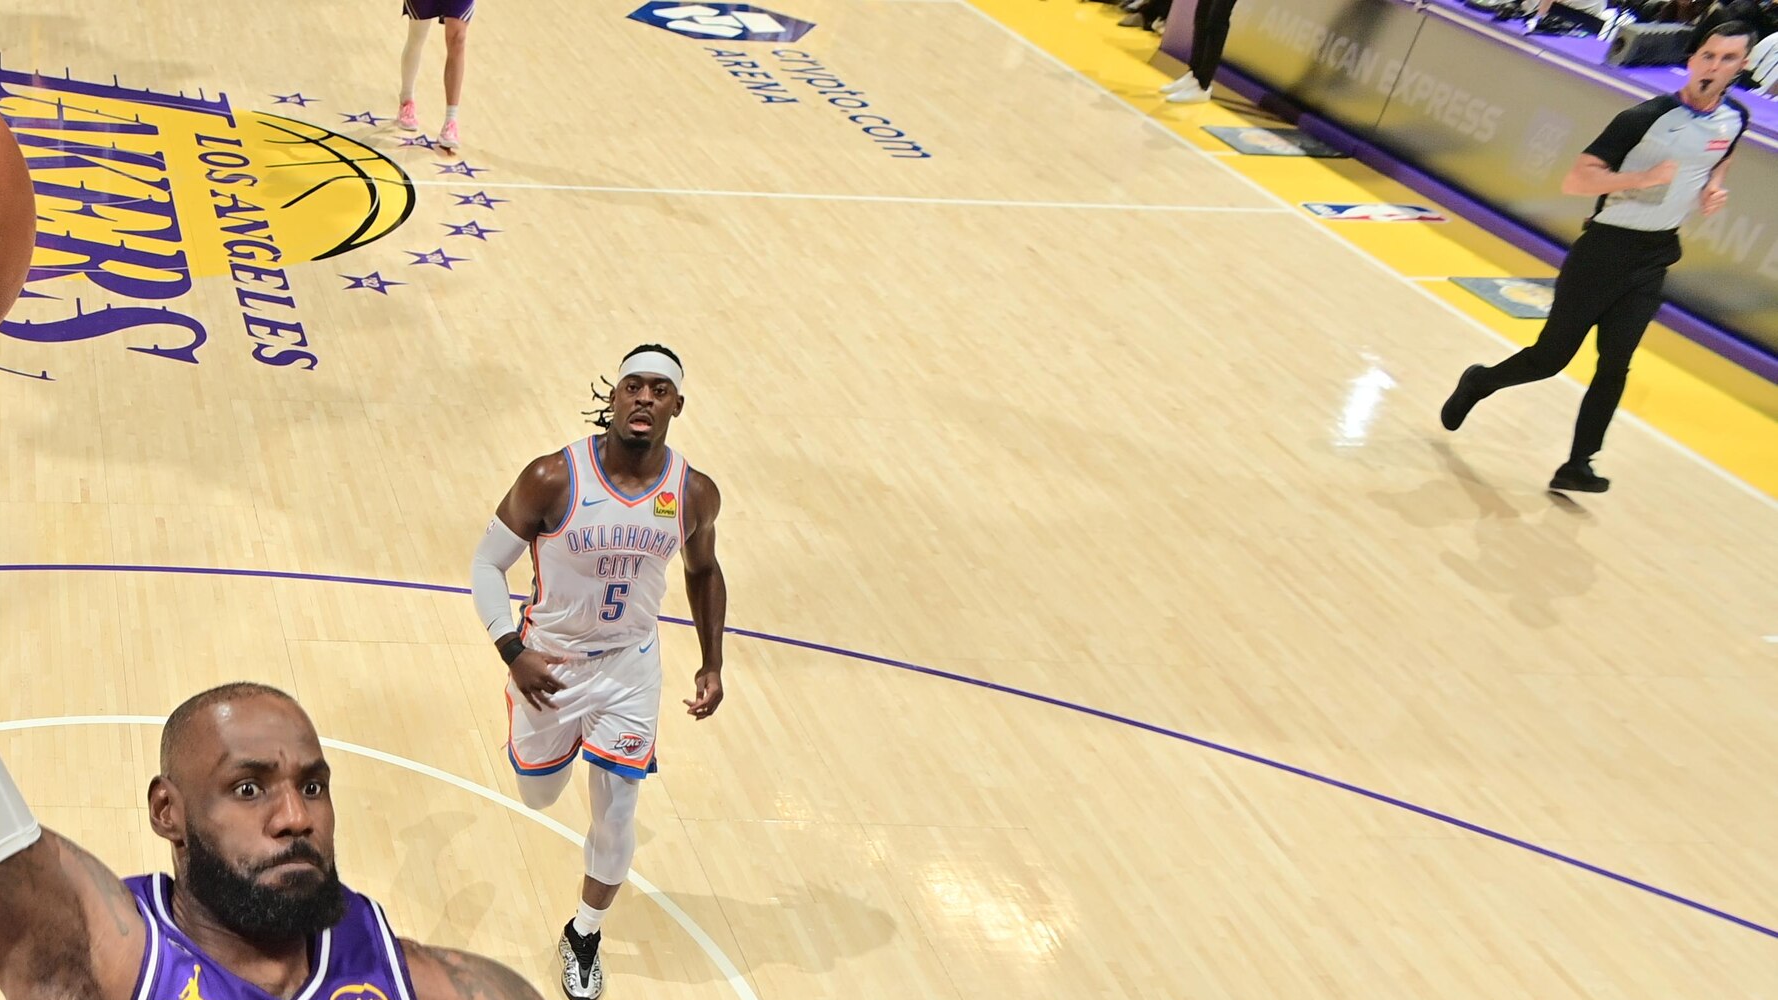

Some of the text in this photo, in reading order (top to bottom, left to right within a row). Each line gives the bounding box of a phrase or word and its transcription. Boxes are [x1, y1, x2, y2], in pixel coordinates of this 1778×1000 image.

[703, 47, 800, 104] ARENA
[771, 48, 931, 159] crypto.com
[1376, 58, 1505, 143] EXPRESS
[195, 132, 319, 371] LOS ANGELES
[565, 523, 679, 561] OKLAHOMA
[596, 554, 646, 579] CITY
[598, 581, 633, 624] 5
